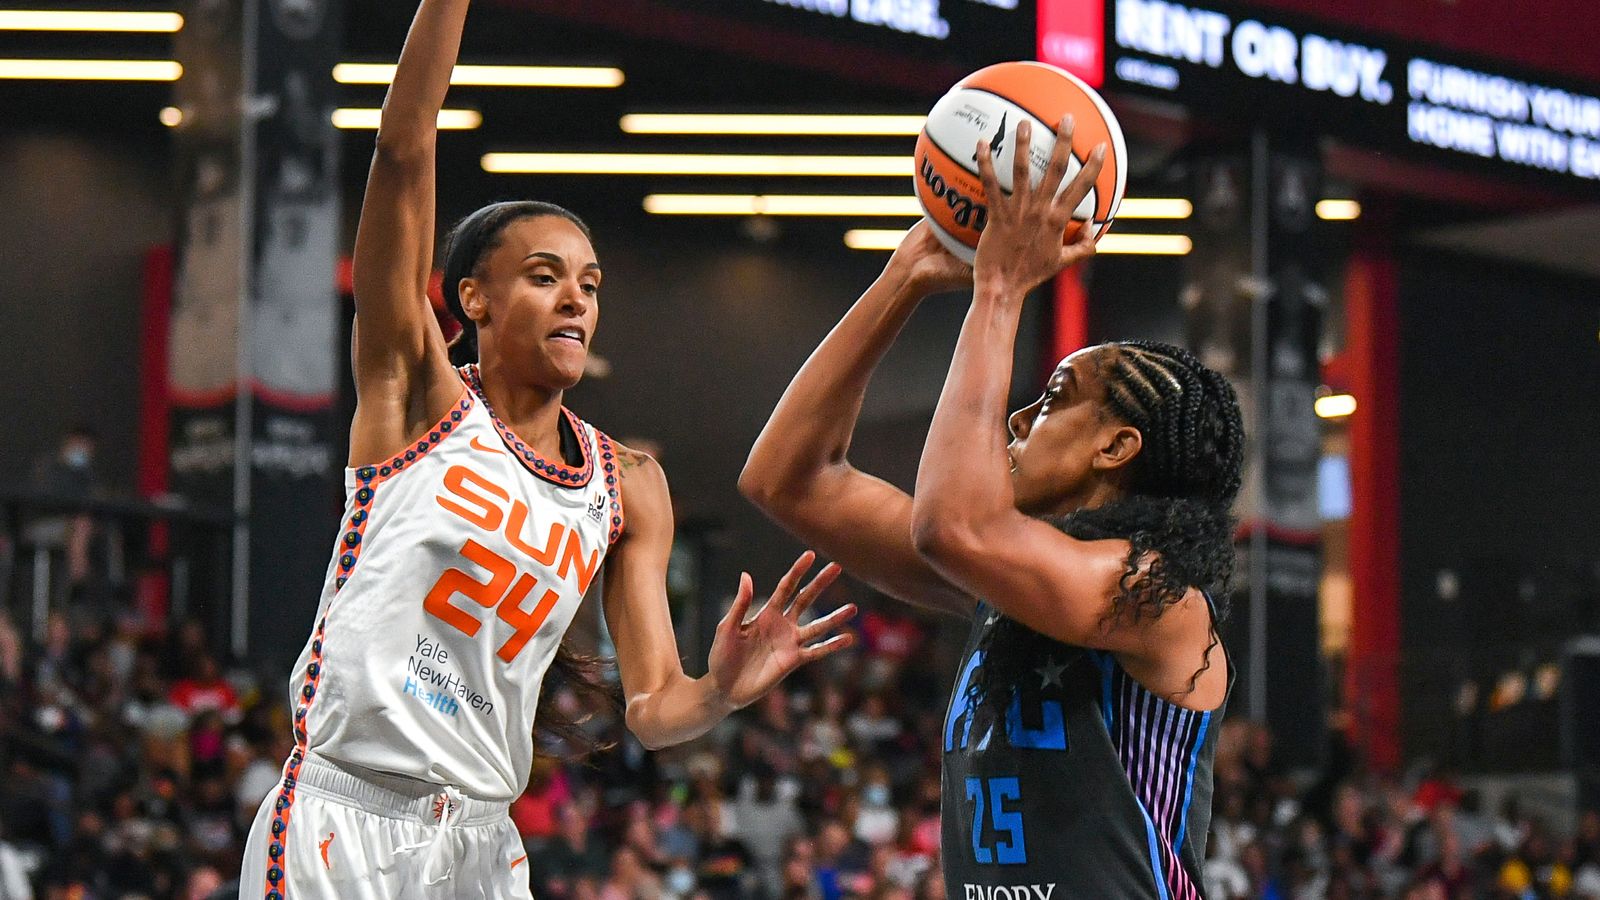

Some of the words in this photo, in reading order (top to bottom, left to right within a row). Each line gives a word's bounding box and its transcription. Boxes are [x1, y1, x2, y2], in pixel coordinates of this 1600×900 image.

[1115, 0, 1230, 67] RENT
[1232, 20, 1298, 84] OR
[1301, 34, 1393, 105] BUY.
[1407, 58, 1530, 122] FURNISH
[1529, 84, 1600, 139] YOUR
[1407, 102, 1496, 158] HOME
[1496, 121, 1568, 174] WITH
[920, 153, 988, 232] ilson
[436, 465, 599, 597] SUN
[587, 502, 604, 522] POST
[422, 538, 560, 664] 24
[407, 656, 494, 716] NewHaven
[414, 633, 449, 664] Yale
[403, 676, 459, 717] Health
[964, 776, 1027, 864] 25
